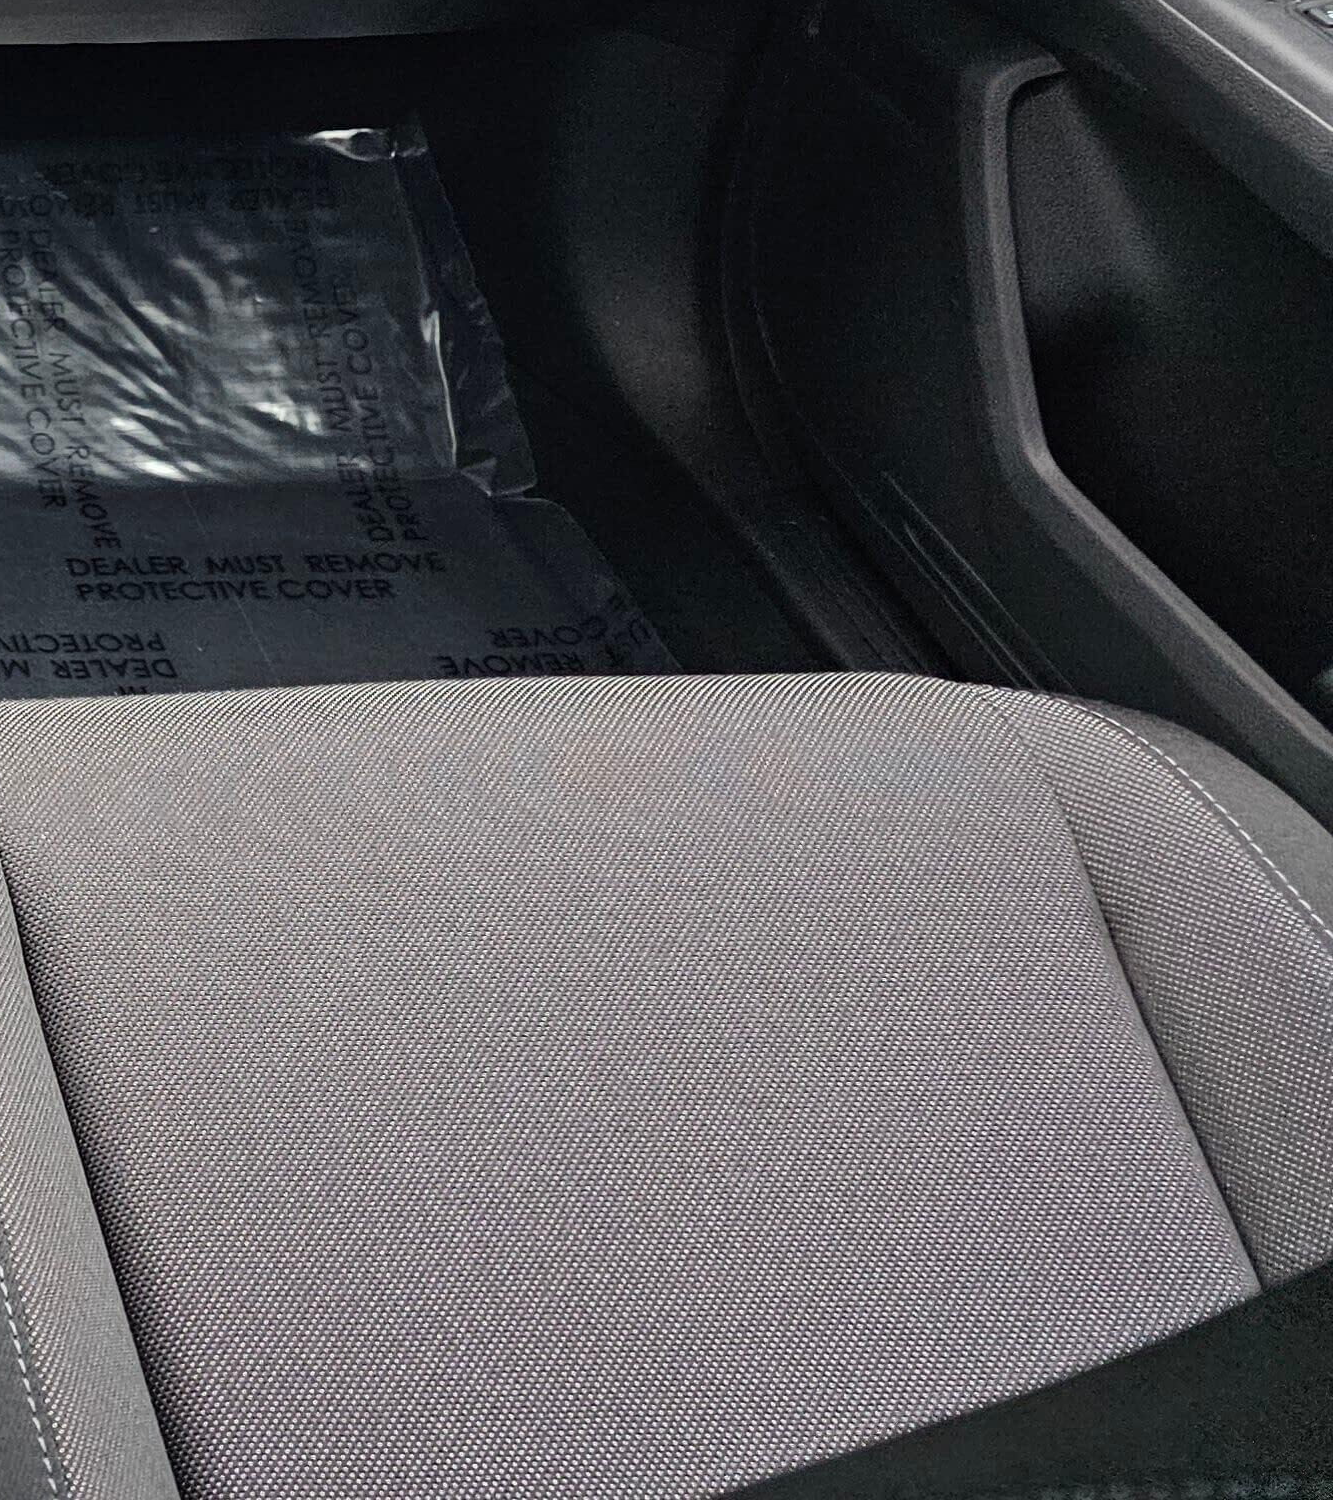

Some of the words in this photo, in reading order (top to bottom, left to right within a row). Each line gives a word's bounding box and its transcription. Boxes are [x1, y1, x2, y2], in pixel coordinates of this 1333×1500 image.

[49, 352, 87, 425] MUST
[317, 359, 352, 433] MUST
[26, 406, 67, 510] COVER
[67, 444, 122, 550] REMOVE
[64, 556, 190, 577] DEALER
[205, 554, 285, 576] MUST
[306, 551, 445, 574] REMOVE
[75, 580, 269, 601] PROTECTIVE
[277, 579, 399, 600] COVER
[50, 657, 179, 680] DEALER
